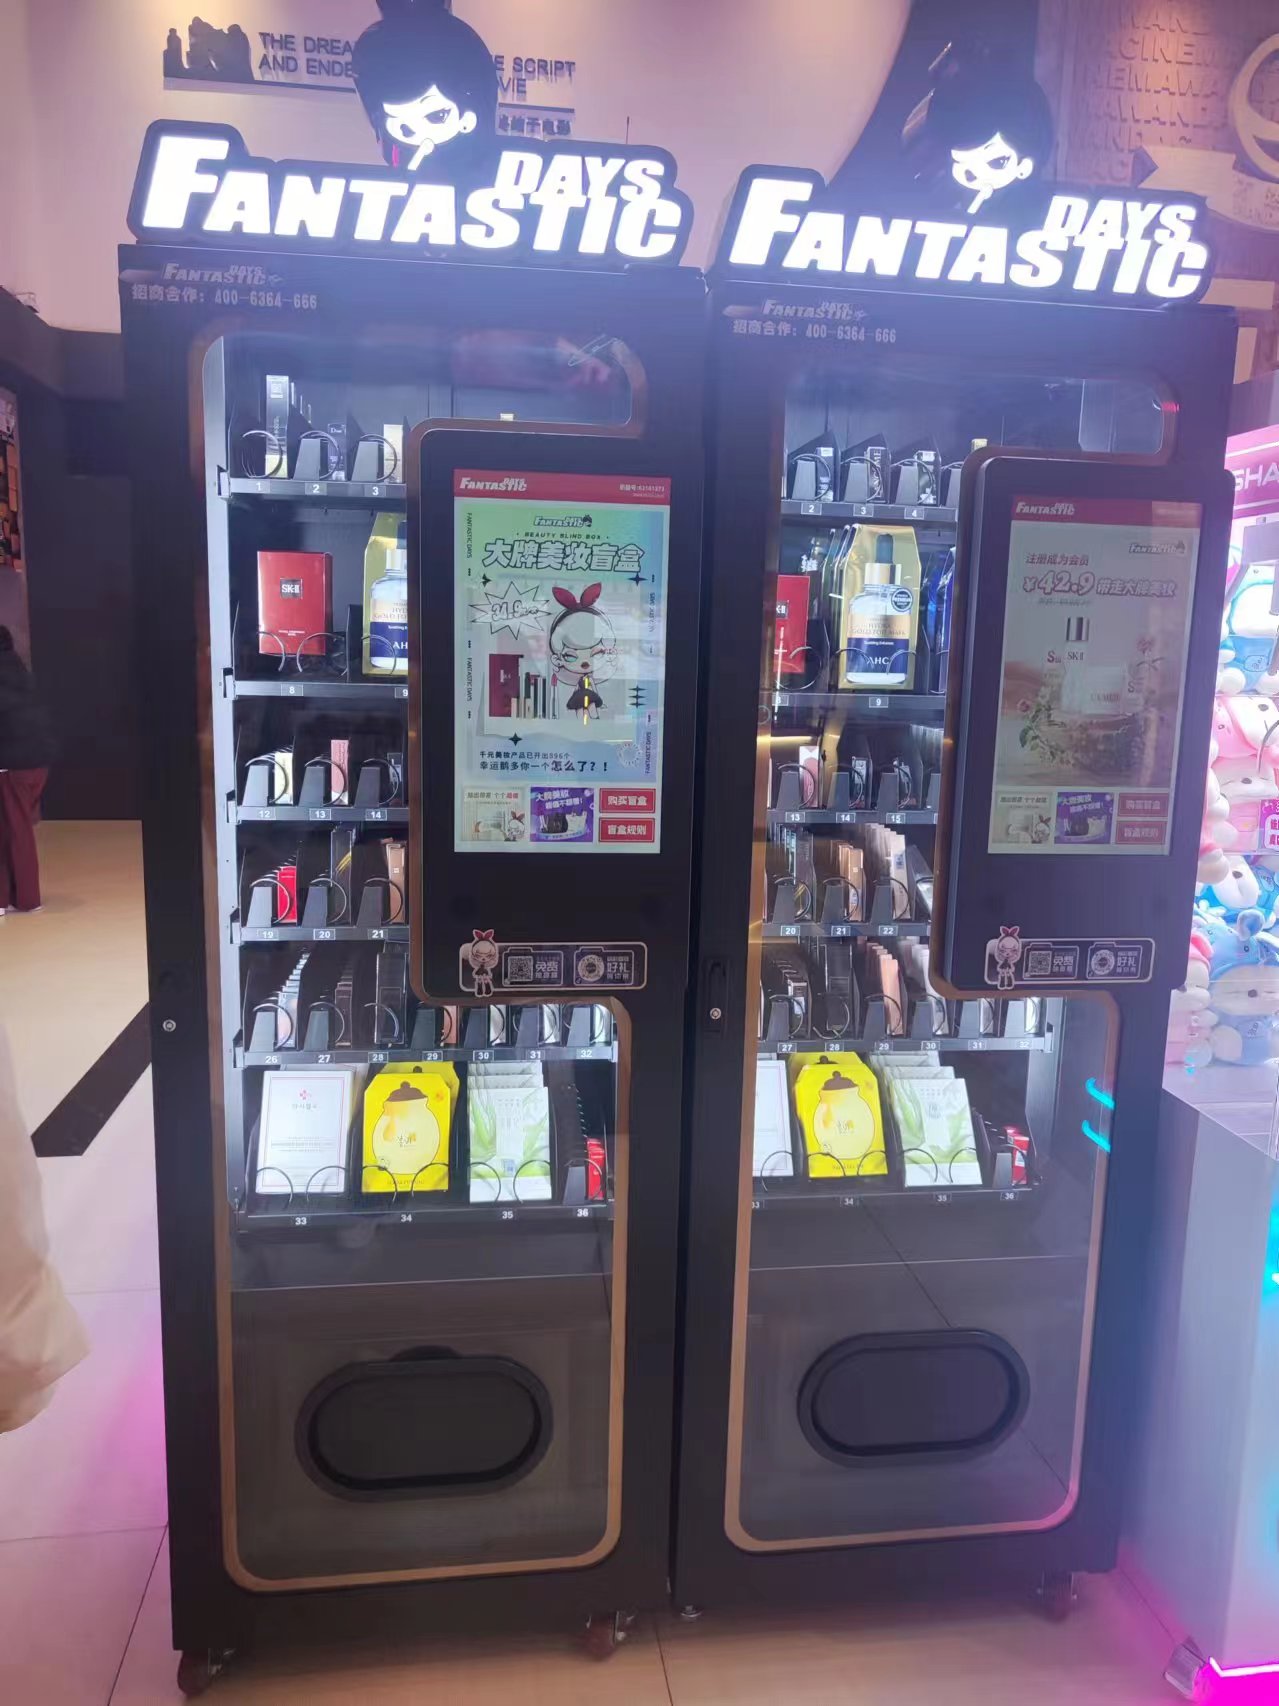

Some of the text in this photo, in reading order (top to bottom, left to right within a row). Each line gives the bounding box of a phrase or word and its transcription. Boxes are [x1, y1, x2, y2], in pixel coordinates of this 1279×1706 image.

[259, 32, 296, 51] THE
[259, 53, 298, 73] AND
[513, 56, 576, 77] SCRIPT
[494, 151, 665, 202] DAYS
[142, 136, 682, 258] FANTASTIC
[1043, 195, 1196, 246] DAYS
[729, 178, 1208, 298] FANTASTIC
[163, 263, 266, 285] FANTASTIC
[762, 299, 852, 320] FANTASTIC
[256, 482, 262, 491] 1
[459, 476, 527, 491] FANTASTIC
[312, 484, 320, 493] 2
[372, 487, 379, 496] 3
[809, 505, 815, 513] 2
[860, 507, 866, 515] 3
[1016, 502, 1075, 515] FANTASTIC
[911, 509, 918, 518] 4
[534, 516, 583, 528] FANTASTIC
[482, 538, 645, 573] 大牌美妆盲盒
[1025, 553, 1089, 567] 注册成为会员
[868, 656, 890, 665] AHC
[402, 689, 408, 697] 9
[876, 698, 882, 706] 9
[607, 795, 648, 806] 购买盲盒
[370, 811, 381, 819] 14
[840, 814, 851, 822] 14
[607, 825, 647, 836] 盲盒规则
[263, 931, 274, 939] 19
[372, 930, 384, 938] 21
[785, 927, 796, 935] 20
[836, 927, 847, 935] 21
[883, 927, 894, 935] 22
[1053, 955, 1074, 966] 免费
[1117, 957, 1136, 967] 好礼
[535, 961, 559, 972] 免费
[607, 962, 630, 973] 好礼
[782, 1044, 793, 1052] 27
[829, 1043, 840, 1051] 28
[878, 1042, 890, 1050] 29
[925, 1041, 937, 1049] 30
[972, 1041, 983, 1049] 31
[1018, 1040, 1030, 1048] 32
[318, 1054, 331, 1063] 27
[372, 1053, 384, 1062] 28
[426, 1052, 438, 1060] 29
[478, 1052, 489, 1060] 30
[530, 1051, 542, 1059] 31
[580, 1050, 593, 1058] 32
[265, 1055, 278, 1064] 26
[502, 1211, 513, 1219] 35
[577, 1208, 589, 1217] 36
[295, 1216, 307, 1225] 33
[400, 1214, 412, 1222] 34
